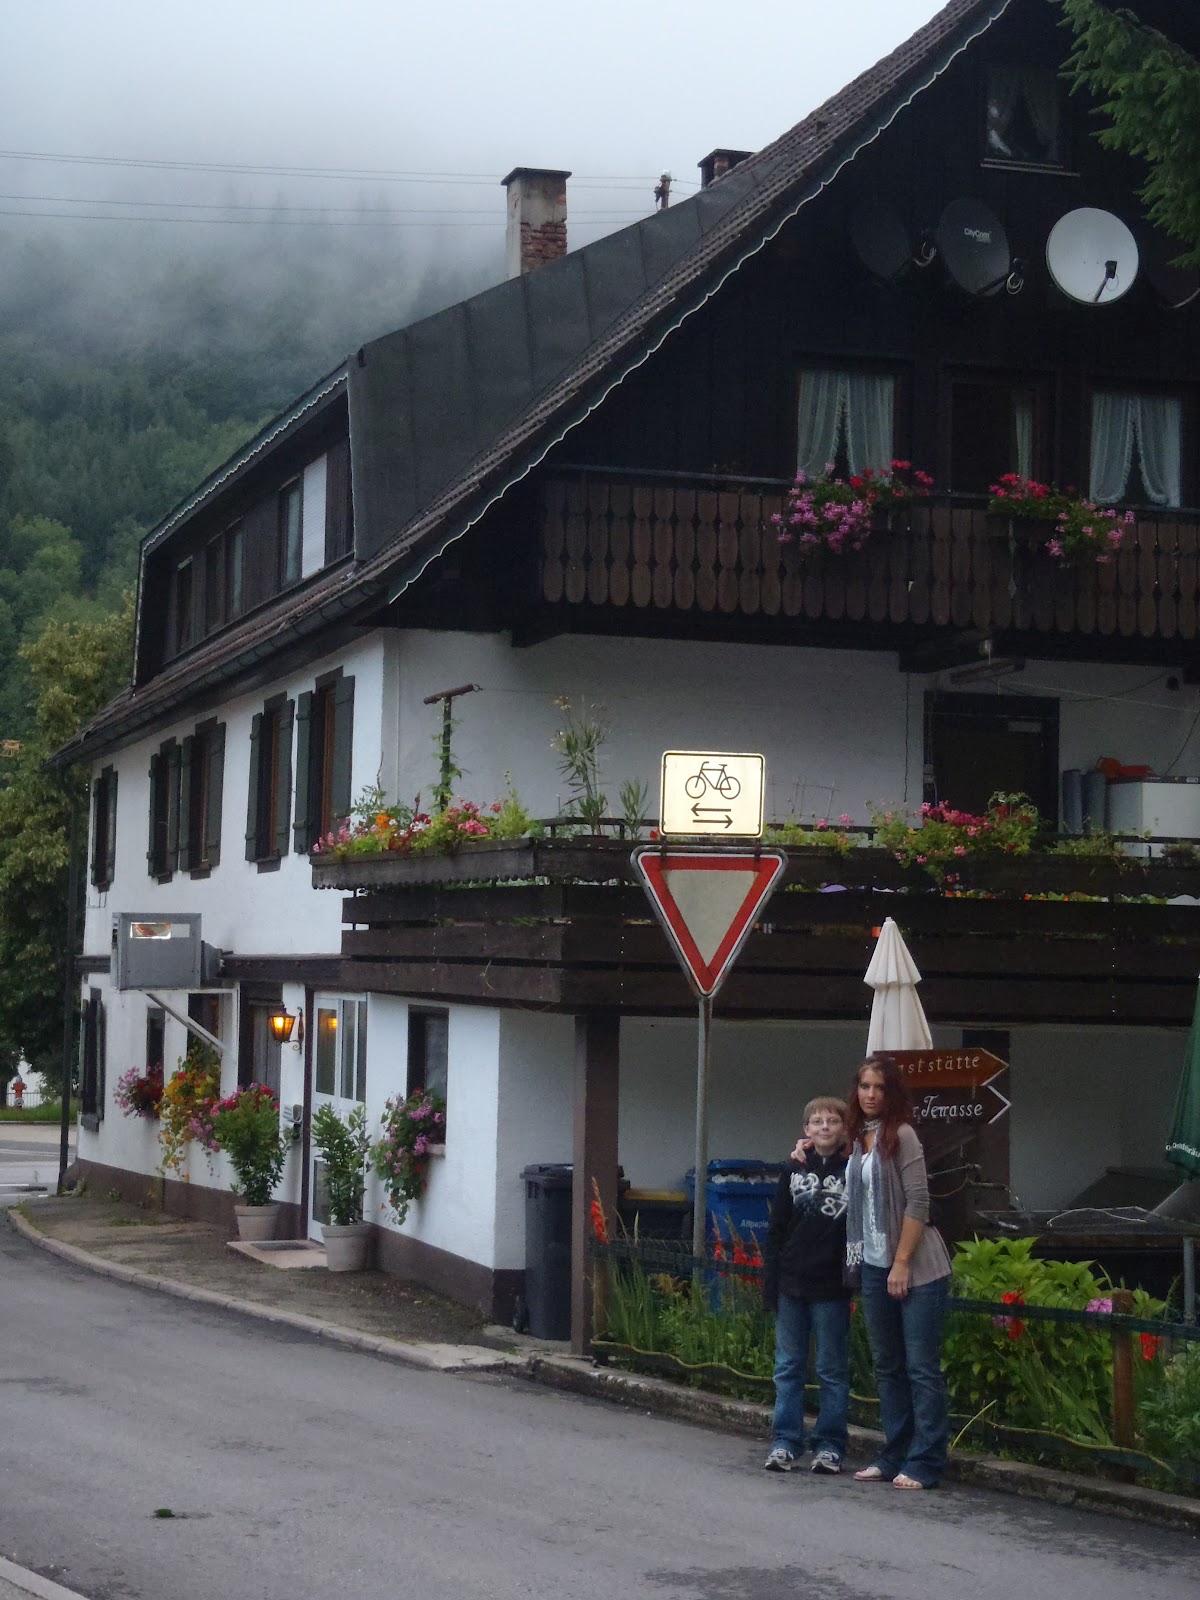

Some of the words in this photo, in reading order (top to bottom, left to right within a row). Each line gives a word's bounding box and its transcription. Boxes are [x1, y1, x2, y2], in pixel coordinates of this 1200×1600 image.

[888, 1055, 980, 1074] ststätte
[920, 1094, 983, 1119] Terrasse
[821, 1196, 848, 1220] 87
[740, 1219, 769, 1229] Altpapie
